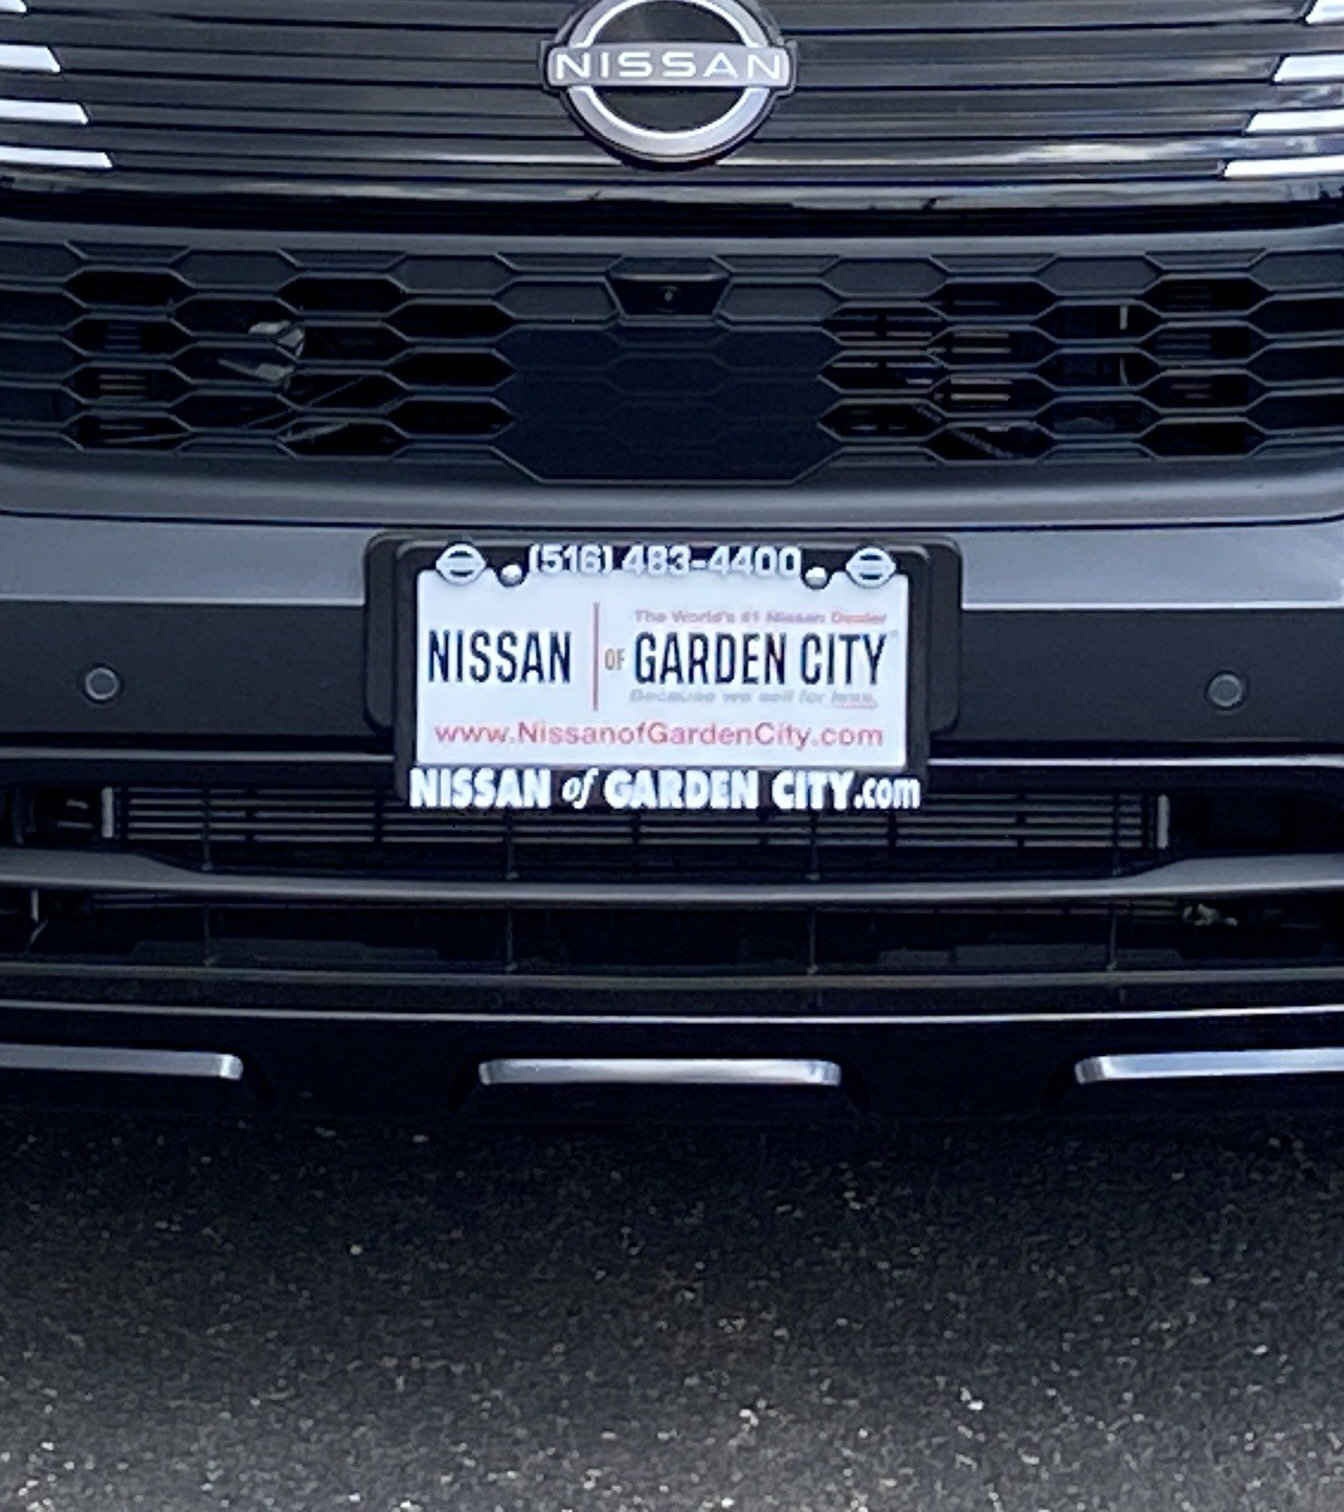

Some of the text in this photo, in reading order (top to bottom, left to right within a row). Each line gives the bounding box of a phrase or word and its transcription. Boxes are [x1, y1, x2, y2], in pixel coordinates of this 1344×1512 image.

[555, 51, 781, 81] NISSAN
[527, 543, 803, 577] (516) 483-4400
[634, 609, 667, 624] The
[671, 609, 736, 624] World's
[765, 610, 826, 625] Nissan
[830, 610, 888, 626] Dealer
[427, 629, 888, 686] NISSAN OF GARDEN CITY
[629, 689, 715, 704] Because
[722, 691, 752, 704] we
[758, 689, 795, 704] sell
[799, 689, 825, 705] for
[434, 721, 884, 751] www.NissanofGardenCity.com
[408, 767, 552, 809] NISSAN
[561, 767, 600, 810] of
[603, 768, 759, 810] GARDEN
